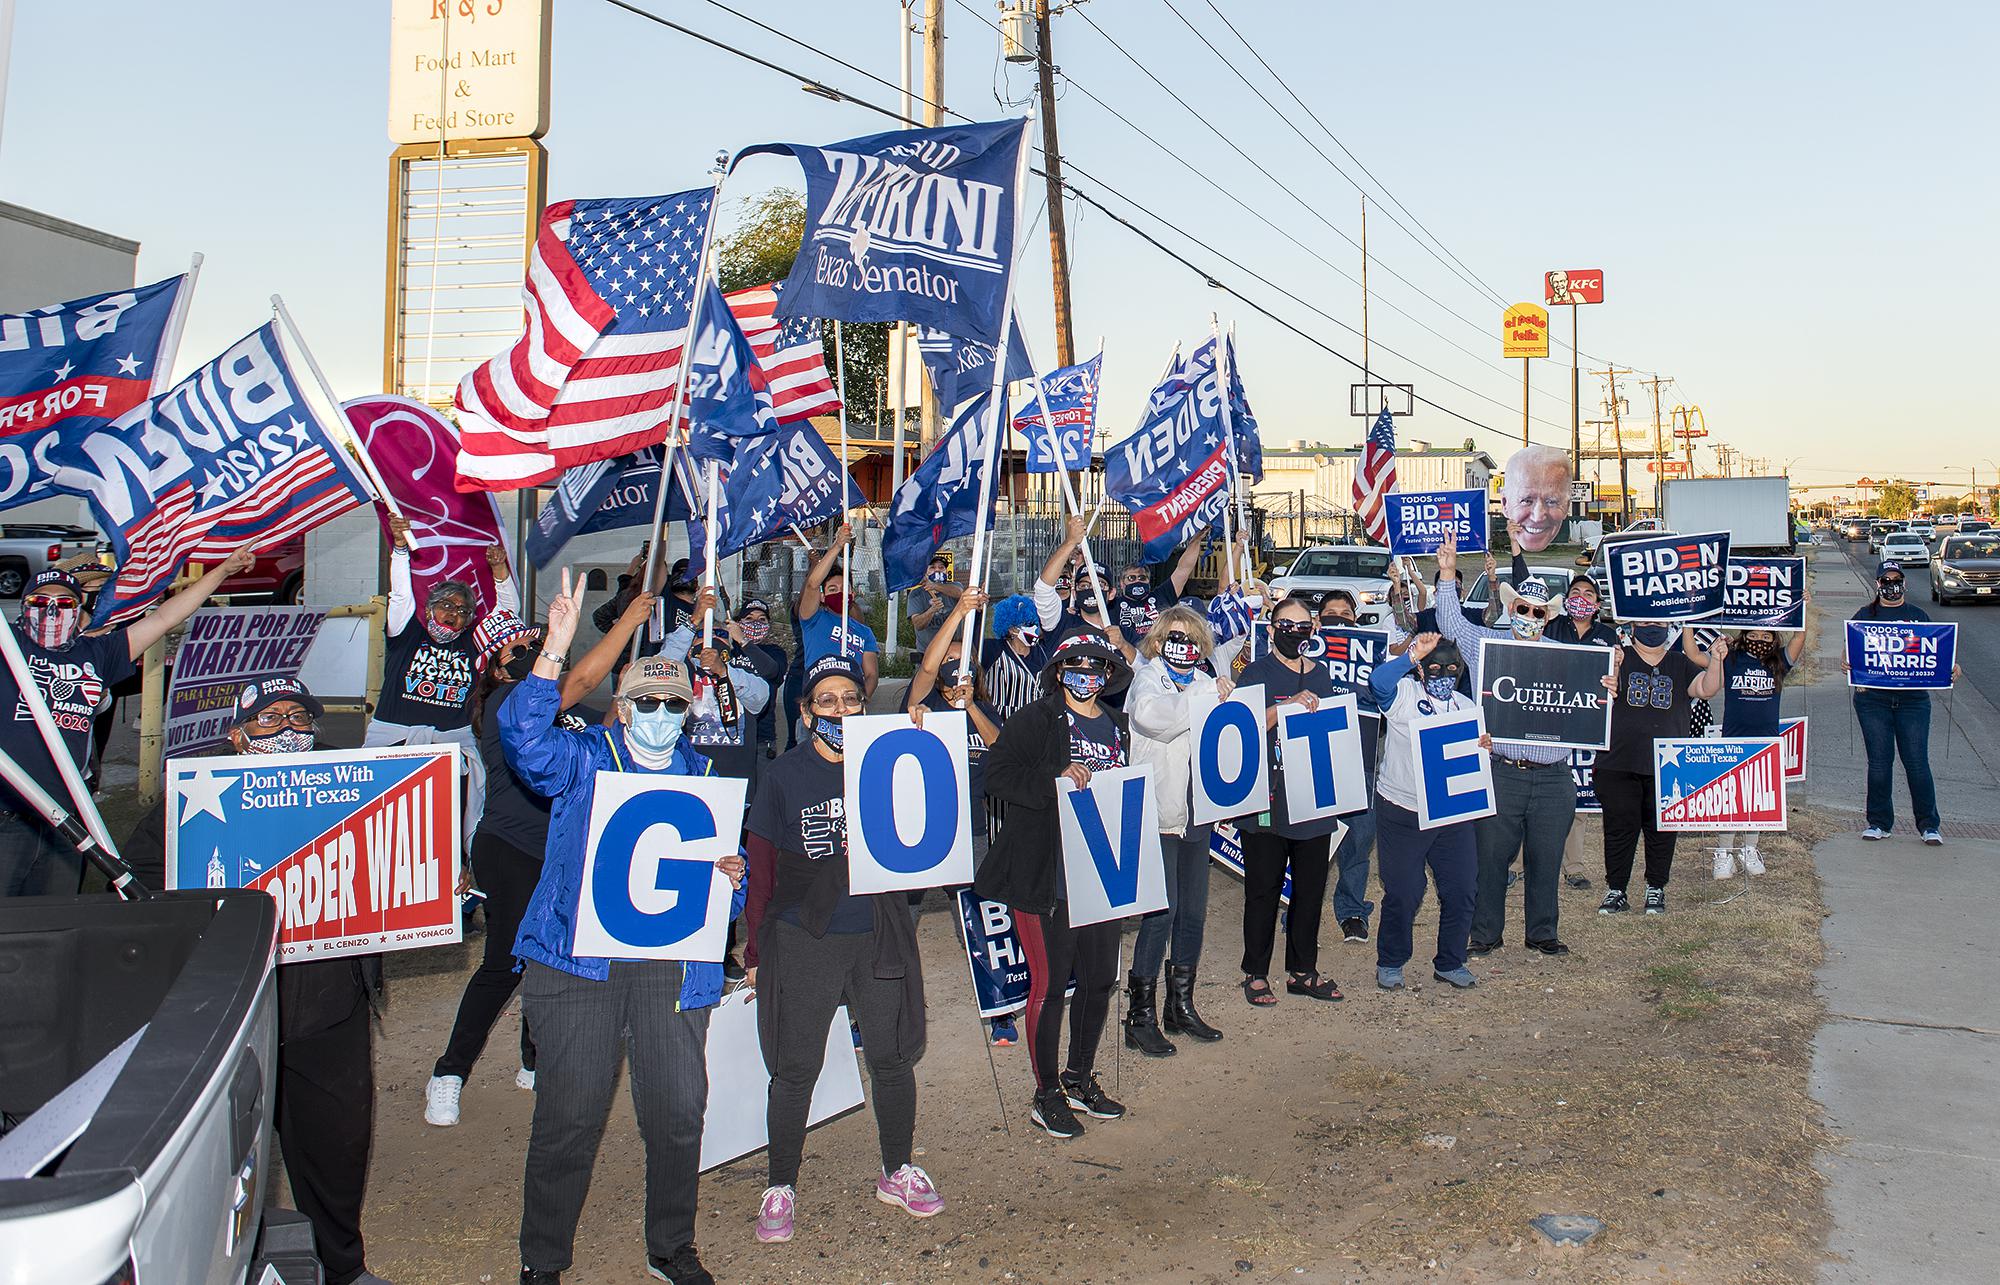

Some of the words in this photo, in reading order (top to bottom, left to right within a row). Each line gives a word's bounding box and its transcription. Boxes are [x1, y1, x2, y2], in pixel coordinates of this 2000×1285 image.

[415, 52, 461, 72] Food
[471, 50, 517, 67] Mart
[454, 80, 473, 97] &
[413, 111, 457, 131] Feed
[465, 109, 515, 128] Store
[815, 246, 852, 288] Texas
[852, 253, 959, 304] Senator
[1569, 279, 1600, 290] KFC
[955, 345, 985, 376] xas
[602, 483, 650, 510] ator
[1401, 495, 1433, 504] TODOS
[1400, 502, 1470, 522] BIDEN
[1402, 520, 1471, 536] HARRIS
[1621, 541, 1720, 577] BIDEN
[1622, 568, 1721, 597] HARRIS
[1726, 565, 1792, 588] DEN
[1650, 594, 1706, 608] JoeBiden.com
[1722, 588, 1793, 607] ARRIS
[1758, 608, 1785, 616] 30330
[190, 614, 246, 641] VOTA
[244, 613, 291, 639] POR
[287, 613, 326, 636] JOE
[831, 625, 866, 650] BDEN
[1864, 625, 1898, 635] TODOS
[1306, 633, 1374, 663] DEN
[1864, 635, 1938, 654] BIDEN
[176, 636, 314, 679] MARTINEZ
[644, 662, 679, 673] BIDEN
[1864, 654, 1938, 669] HARRIS
[644, 669, 680, 678] HARRIS
[1325, 660, 1373, 687] RIS
[1731, 676, 1776, 689] ZAFFIRI
[176, 688, 204, 703] PARA
[404, 675, 469, 703] VOTES
[1627, 671, 1674, 710] 88
[53, 700, 94, 716] HARRIS
[197, 696, 234, 711] DISTRI
[719, 682, 736, 722] BIDEN
[1522, 705, 1572, 714] CONGRESS
[52, 711, 90, 732] 2020
[168, 722, 195, 747] VOTE
[196, 717, 218, 739] JOE
[1286, 705, 1350, 810] T
[1685, 745, 1705, 754] Don't
[1705, 745, 1725, 754] Mess
[1725, 745, 1744, 754] With
[1685, 753, 1710, 763] South
[1712, 754, 1738, 763] Texas
[242, 770, 289, 791] Don't
[290, 768, 331, 788] Mess
[333, 765, 374, 784] With
[1418, 719, 1490, 822] E
[1665, 803, 1685, 821] NO
[1687, 774, 1738, 819] BORDER
[1739, 752, 1776, 813] WALL
[241, 787, 299, 810] South
[301, 786, 360, 808] Texas
[1067, 776, 1146, 909] V
[266, 830, 358, 931] ORDER
[364, 776, 440, 914] WALL
[592, 788, 718, 948] G
[323, 942, 334, 951] EL
[335, 938, 370, 949] CENIZO
[396, 932, 414, 942] SAN
[416, 927, 454, 940] YGNACIO
[275, 946, 295, 957] AVO
[1006, 970, 1028, 984] Text
